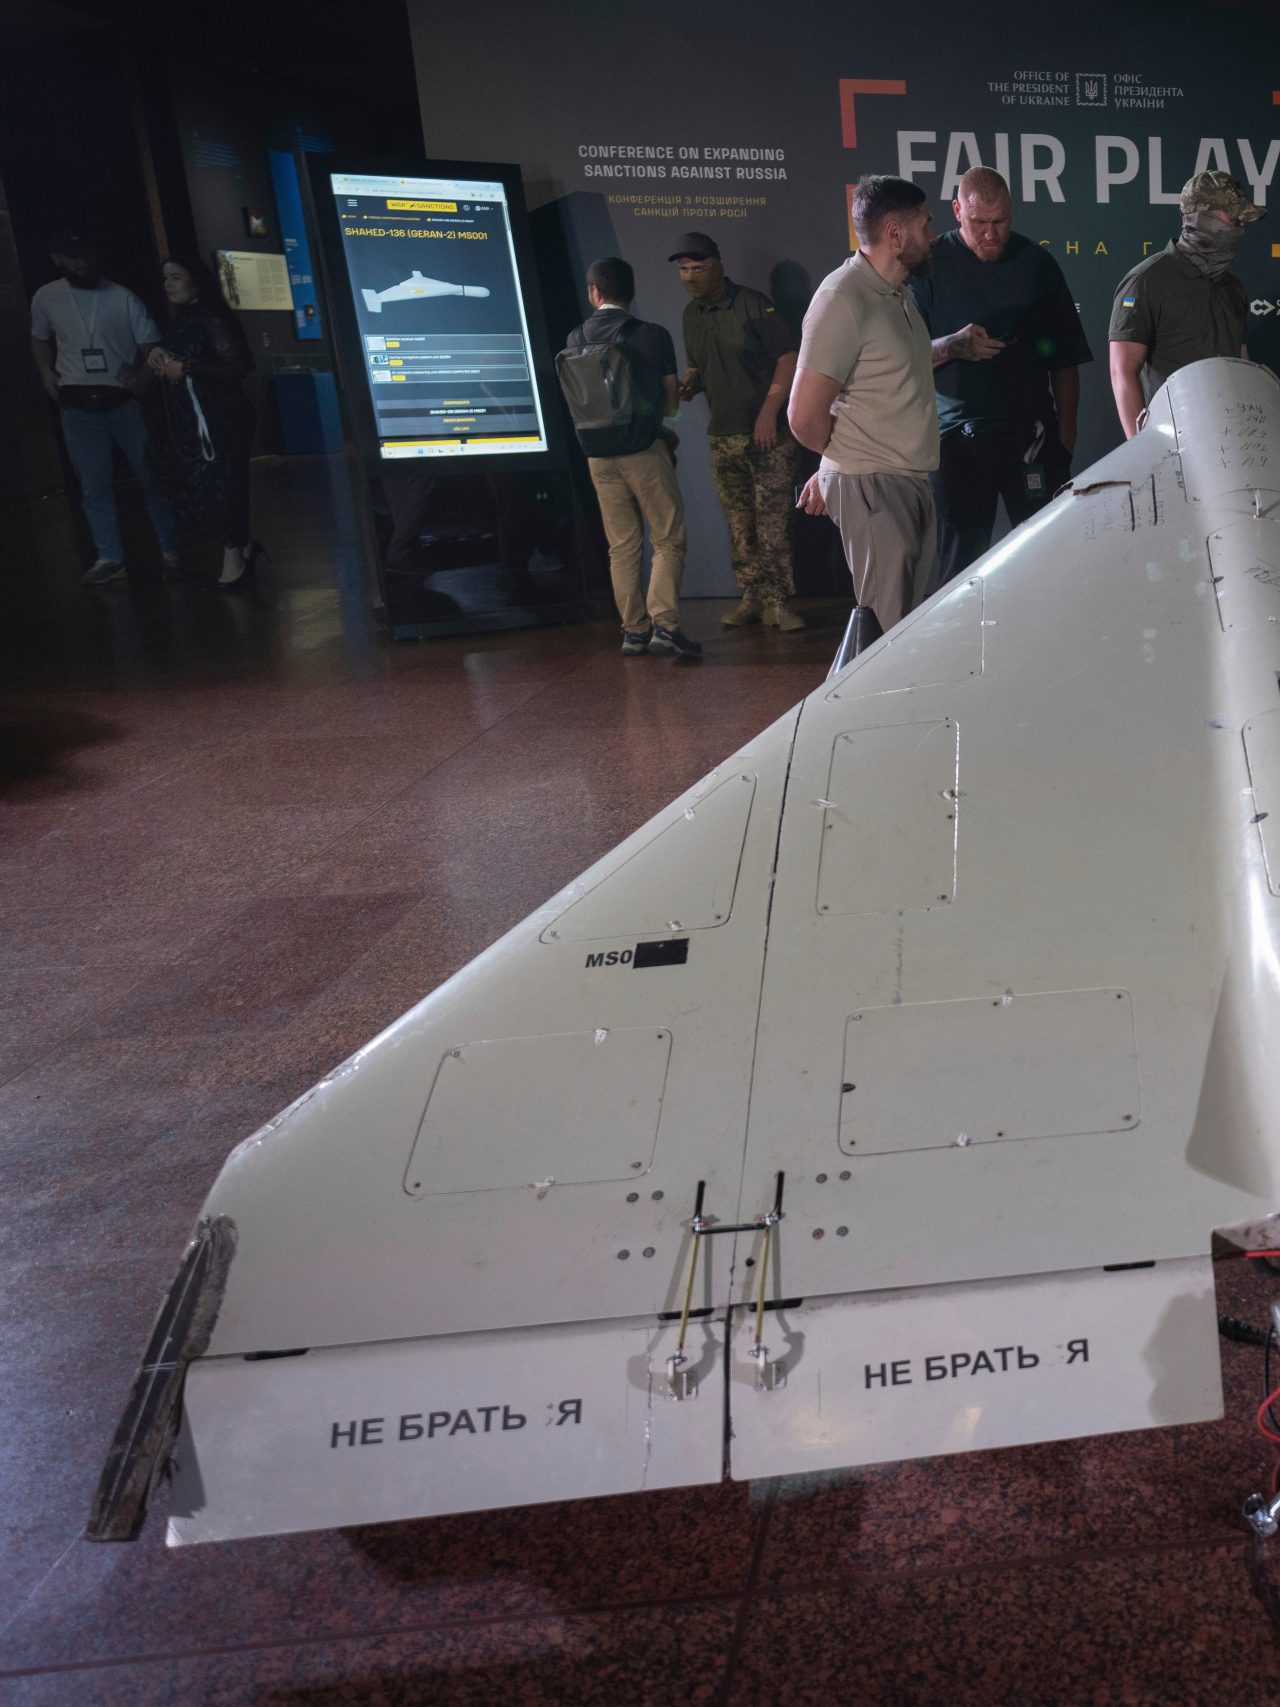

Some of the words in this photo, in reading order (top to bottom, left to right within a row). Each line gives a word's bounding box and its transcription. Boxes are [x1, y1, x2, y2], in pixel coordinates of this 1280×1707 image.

[1014, 70, 1052, 82] OFFICE
[1055, 71, 1070, 82] OF
[1113, 73, 1143, 84] ОФІС
[987, 82, 1010, 92] THE
[1012, 83, 1070, 94] PRESIDENT
[1114, 85, 1185, 97] ПРЕЗИДЕНТА
[1002, 95, 1017, 105] OF
[1020, 95, 1070, 106] UKRAINE
[1114, 98, 1165, 109] УКРАЇНИ
[578, 145, 674, 159] CONFERENCE
[679, 147, 699, 160] ON
[704, 147, 785, 161] EXPANDING
[584, 164, 667, 178] SANCTIONS
[671, 166, 731, 179] AGAINST
[736, 167, 787, 180] RUSSIA
[897, 130, 1066, 203] FAIR
[608, 194, 681, 205] КОНФЕРЕНЦІЯ
[695, 196, 767, 206] РОЗШИРЕННЯ
[634, 206, 679, 217] САНКЦІЙ
[683, 208, 717, 217] ПРОТИ
[344, 227, 407, 238] SHAHED-136
[408, 228, 456, 239] (GERAN-2)
[864, 1359, 912, 1389] НЕ
[330, 1417, 385, 1448] НЕ
